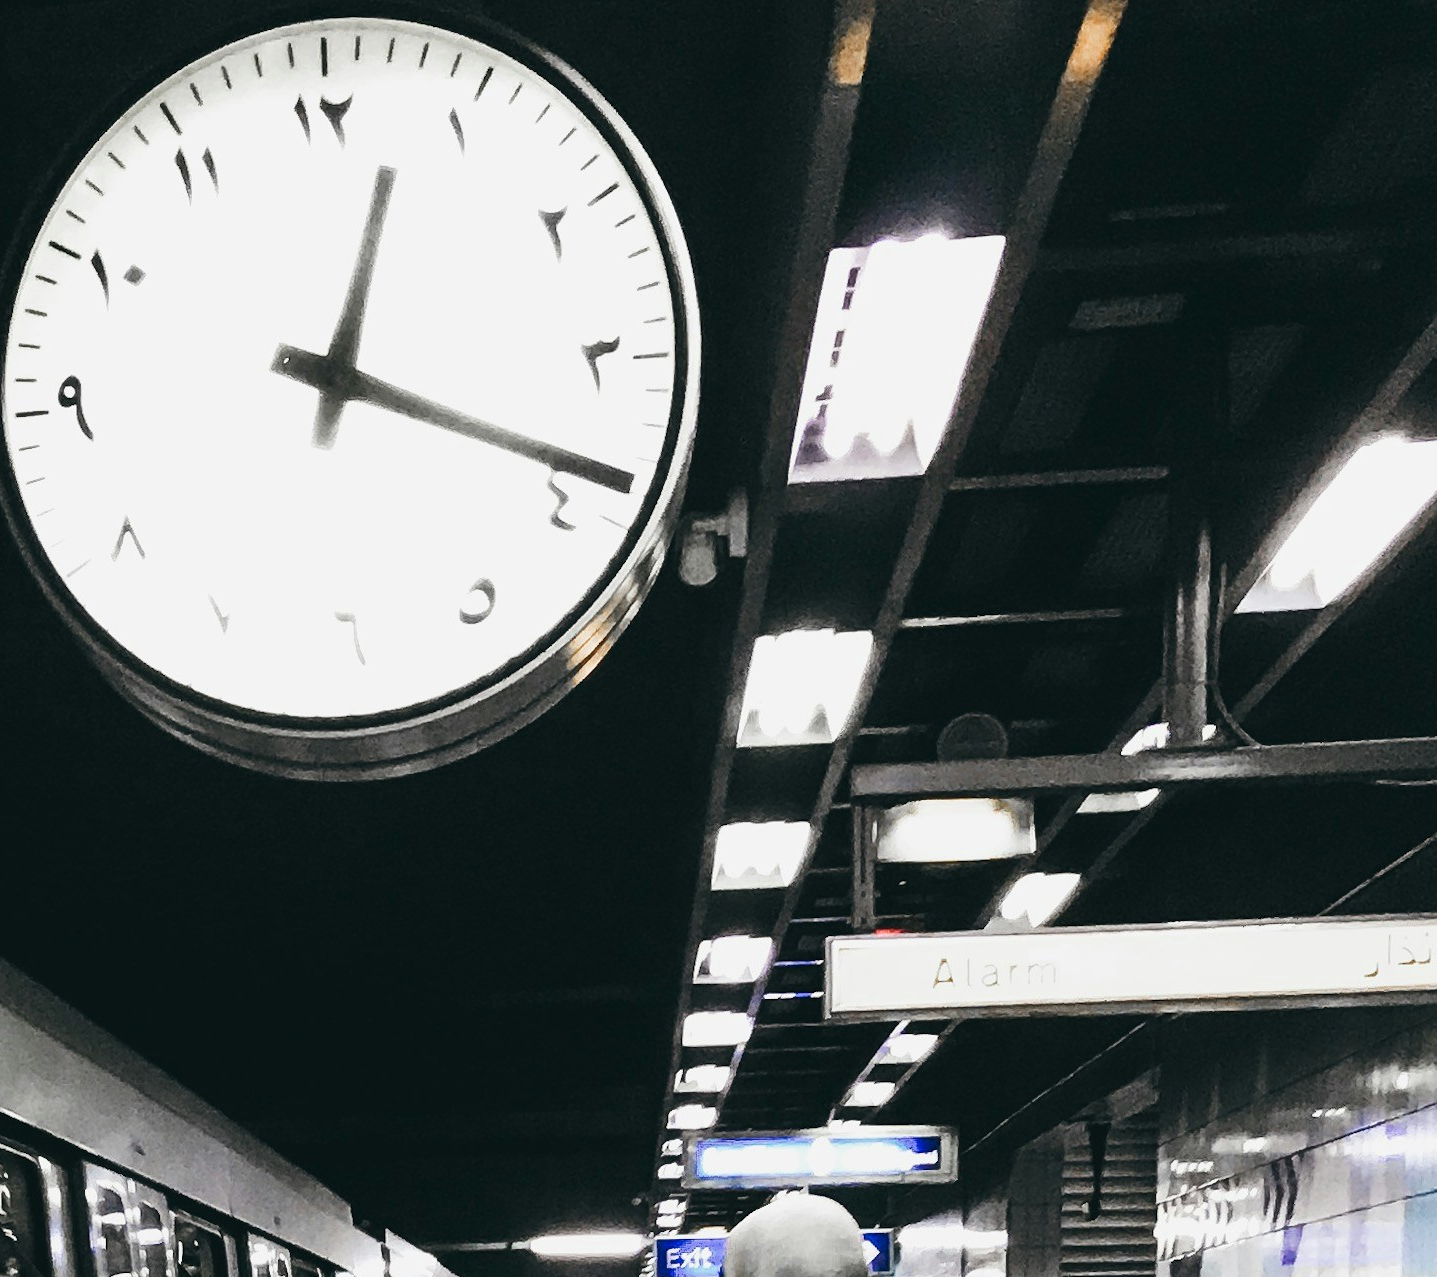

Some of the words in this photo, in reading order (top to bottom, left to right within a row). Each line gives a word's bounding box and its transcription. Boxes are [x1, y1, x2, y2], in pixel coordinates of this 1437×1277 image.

[293, 93, 354, 148] ١٢
[174, 146, 219, 206] ١١
[537, 205, 569, 263] ٢
[57, 374, 95, 442] ٩
[111, 515, 146, 562] ٨
[932, 958, 1057, 989] Alarm
[1363, 931, 1433, 978] نذار
[666, 1246, 713, 1270] Exit
